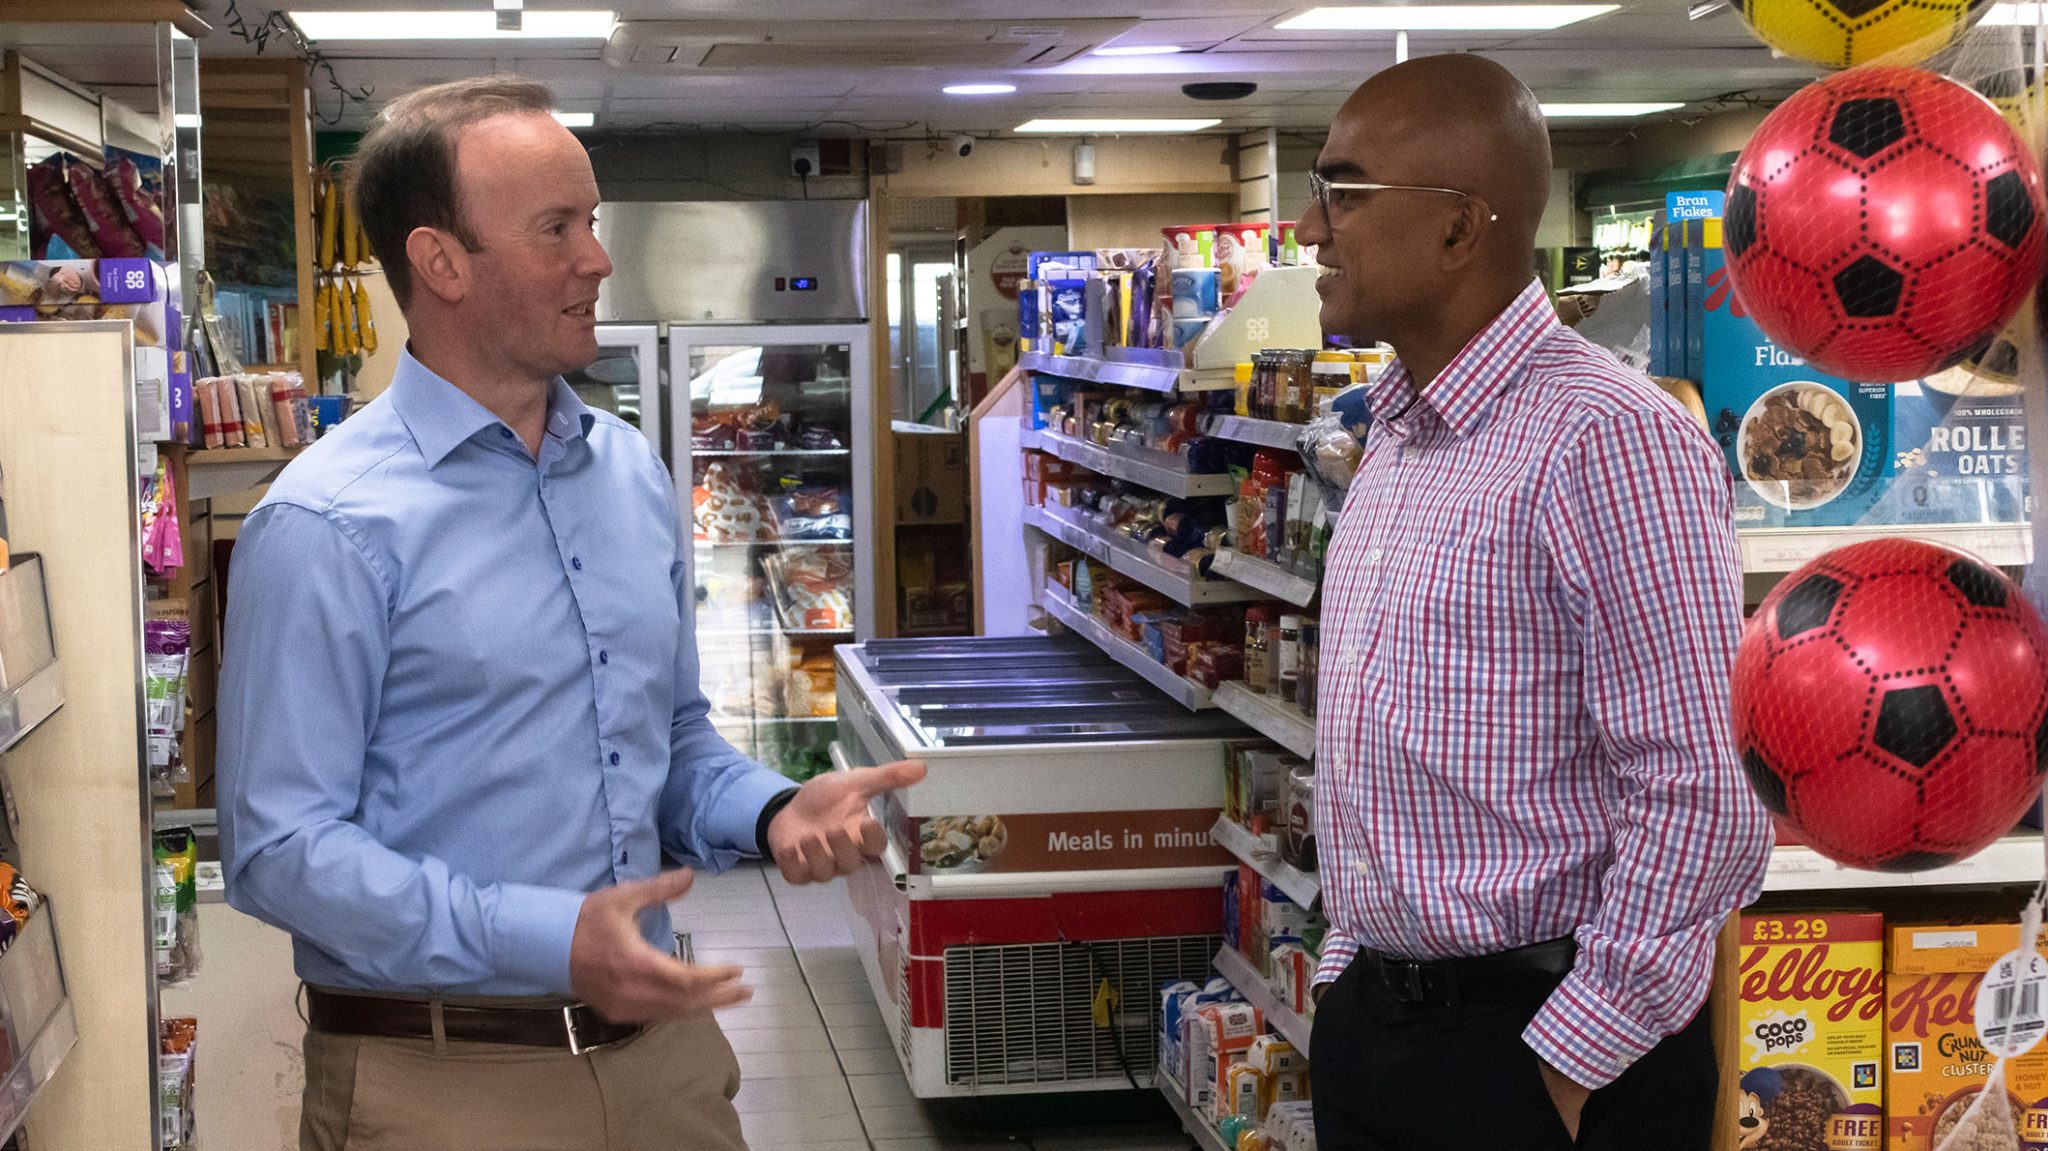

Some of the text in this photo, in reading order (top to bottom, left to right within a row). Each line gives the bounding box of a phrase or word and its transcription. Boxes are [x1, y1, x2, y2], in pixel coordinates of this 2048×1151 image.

[1676, 196, 1708, 206] Bran
[1672, 206, 1713, 218] Flakes
[1958, 454, 2018, 475] OATS
[1048, 830, 1113, 852] Meals
[1123, 828, 1143, 849] in
[1753, 918, 1828, 941] £3.29
[1765, 1033, 1804, 1052] pops
[1959, 1050, 1989, 1063] NUT
[2015, 1073, 2047, 1082] HONEY
[2016, 1082, 2042, 1091] & NUT
[1832, 1119, 1880, 1137] FREE
